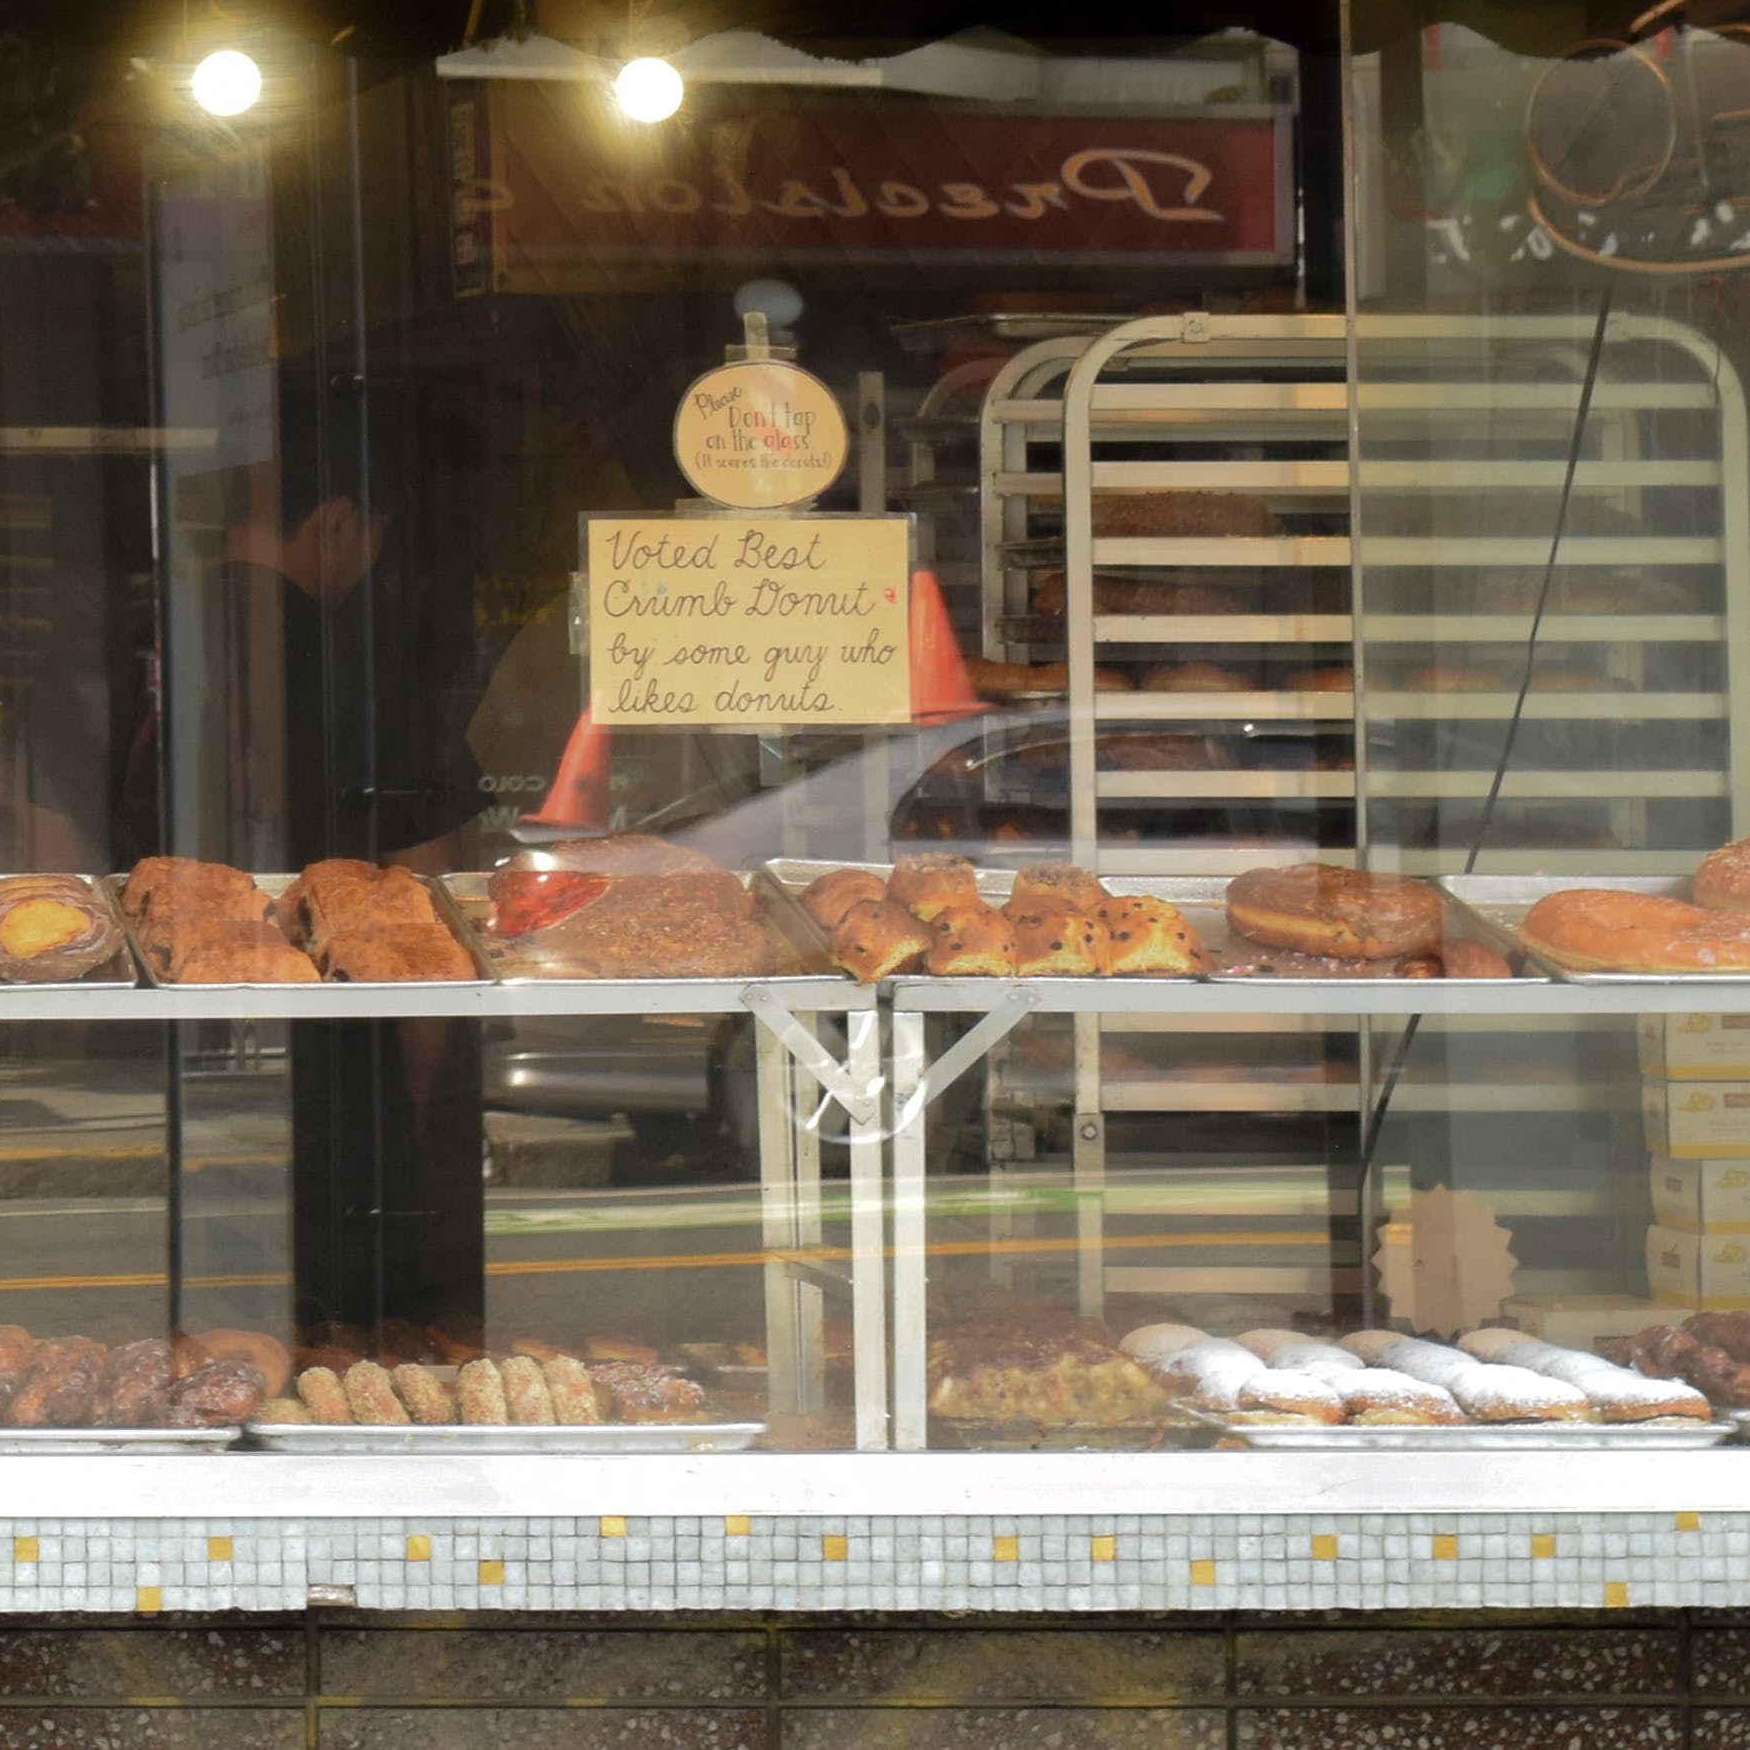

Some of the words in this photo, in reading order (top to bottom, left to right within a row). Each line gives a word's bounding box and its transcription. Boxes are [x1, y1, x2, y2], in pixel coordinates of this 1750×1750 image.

[784, 400, 816, 435] tap
[705, 433, 726, 451] on
[731, 428, 759, 452] the
[605, 529, 720, 570] Voted
[733, 529, 828, 570] Best
[602, 579, 740, 617] Crumb
[744, 577, 876, 617] Donut
[606, 631, 655, 681] by
[662, 644, 750, 666] some
[763, 644, 828, 682] guy
[839, 627, 897, 665] who
[607, 677, 699, 714] likes
